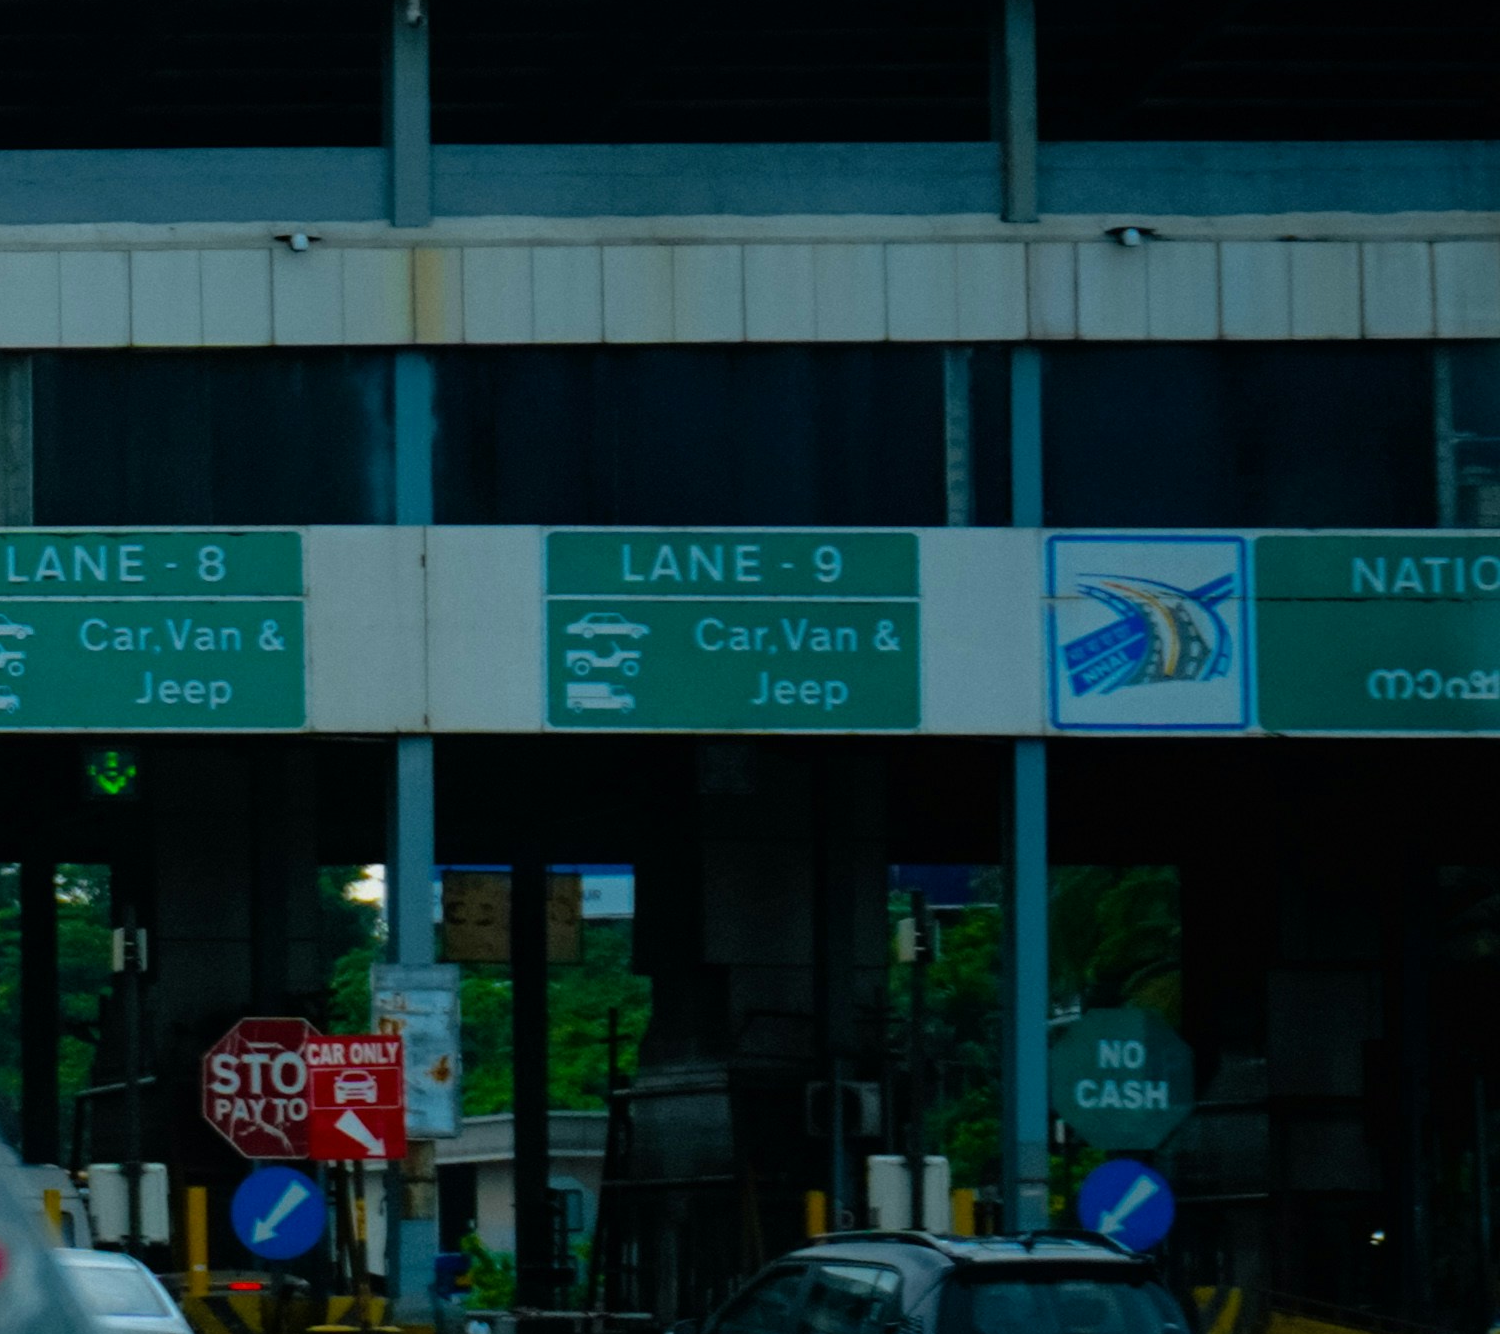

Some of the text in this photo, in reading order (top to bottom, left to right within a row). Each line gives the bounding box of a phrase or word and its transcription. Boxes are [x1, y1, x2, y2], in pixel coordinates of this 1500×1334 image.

[7, 544, 146, 583] LANE
[198, 545, 226, 582] 8
[621, 544, 763, 583] LANE
[813, 545, 843, 583] 9
[258, 619, 285, 652] &
[874, 619, 900, 652] &
[135, 671, 233, 710] Jeep
[751, 671, 848, 710] Jeep
[307, 1042, 399, 1065] CAR ONLY
[1099, 1039, 1145, 1069] NO
[210, 1052, 308, 1095] STO
[214, 1098, 309, 1121] PAY TO
[1076, 1079, 1168, 1109] CASH
